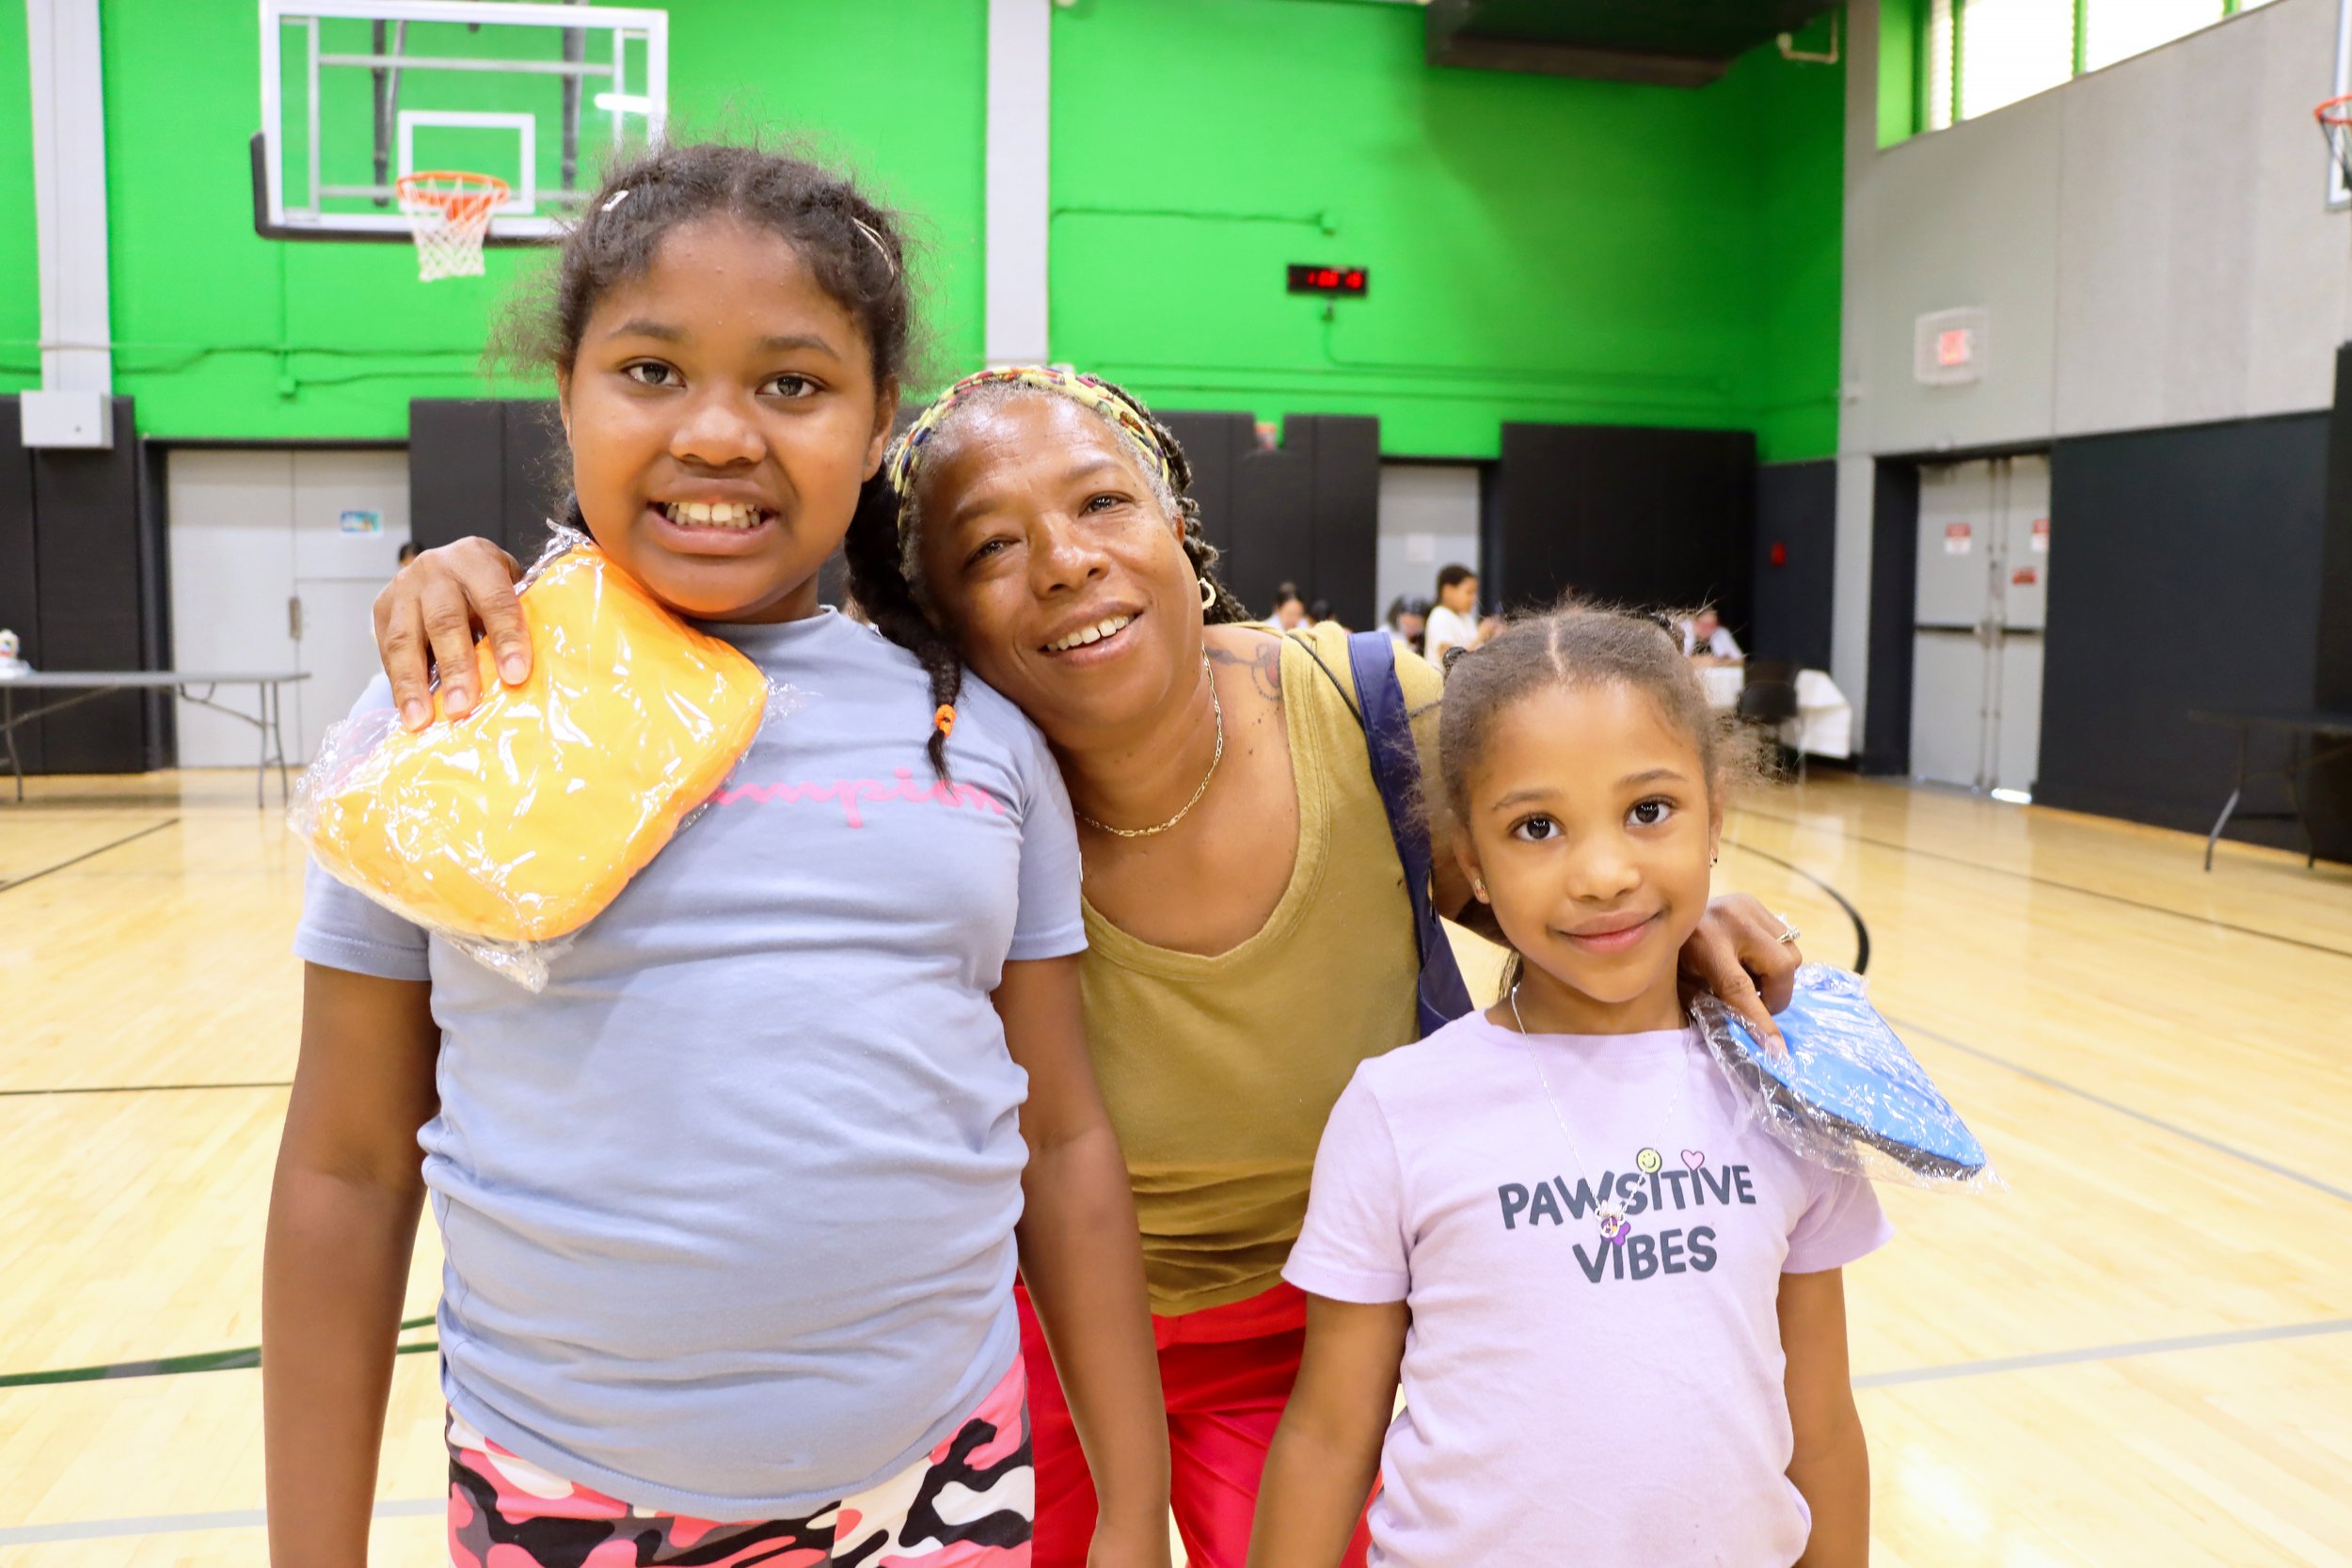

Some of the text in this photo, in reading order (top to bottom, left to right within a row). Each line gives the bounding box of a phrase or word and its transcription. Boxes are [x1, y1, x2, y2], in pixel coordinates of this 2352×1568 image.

[715, 767, 1006, 829] mpion
[1498, 1148, 1757, 1230] PAWSITIVE
[1572, 1225, 1718, 1284] VIBES
